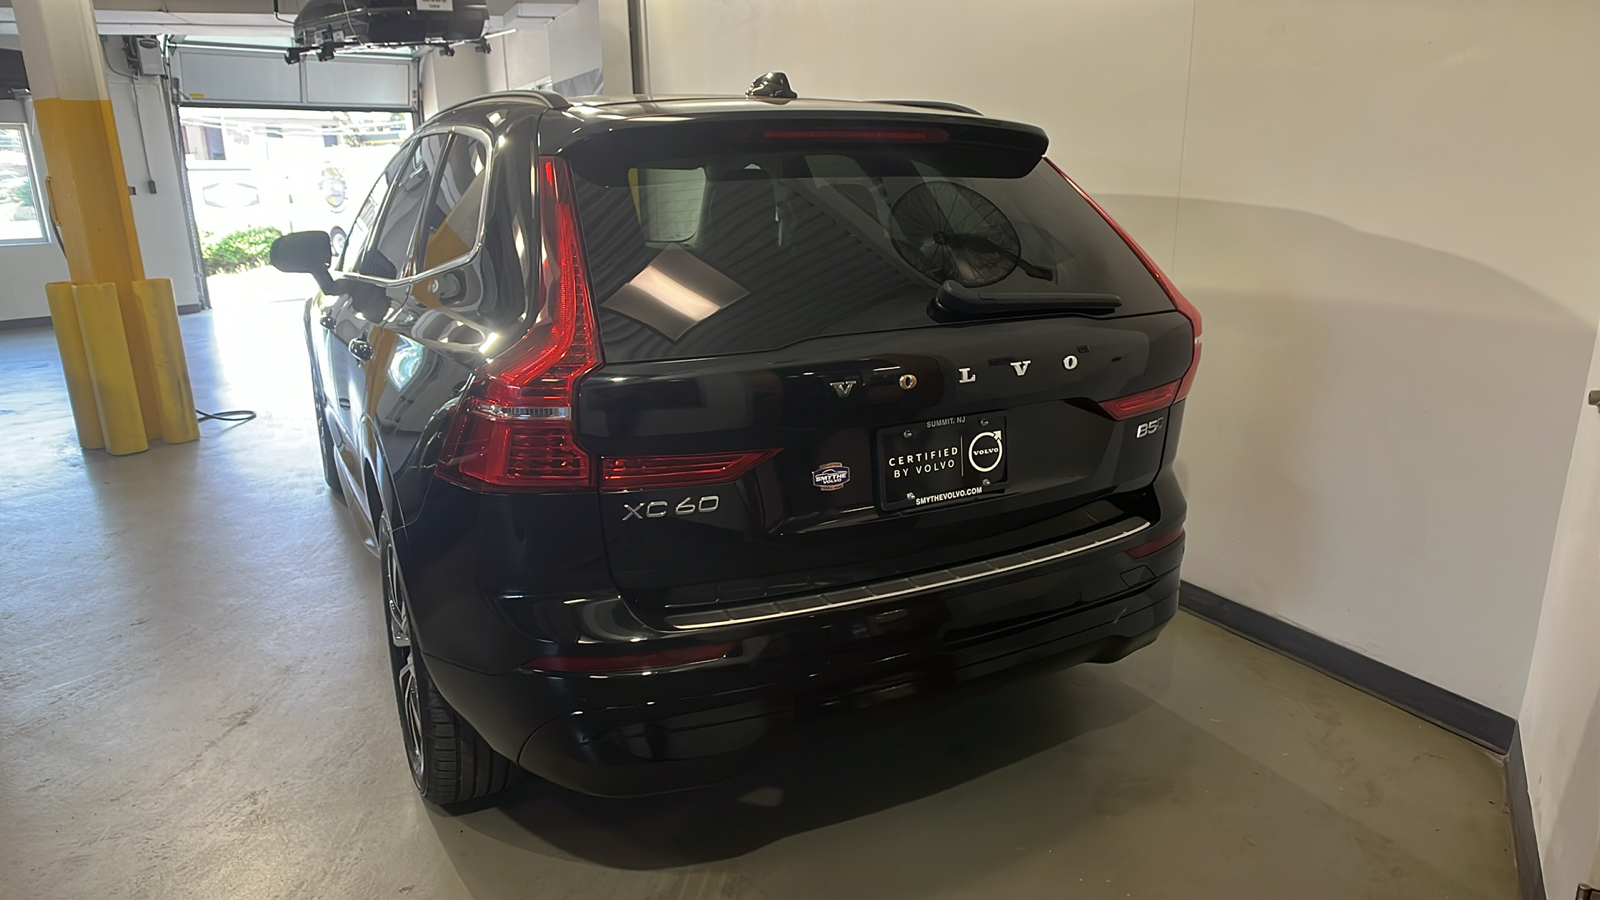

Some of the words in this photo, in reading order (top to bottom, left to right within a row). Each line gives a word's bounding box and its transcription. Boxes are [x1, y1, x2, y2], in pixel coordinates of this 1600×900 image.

[829, 354, 1078, 398] VOLVO
[956, 416, 966, 424] NJ
[888, 446, 958, 467] CERTIFIED
[973, 447, 999, 456] VOLVO
[815, 472, 847, 482] SMYTHE
[893, 467, 909, 479] BY
[915, 459, 955, 474] VOLVO
[915, 486, 983, 506] SMYTHEVOLVO.COM
